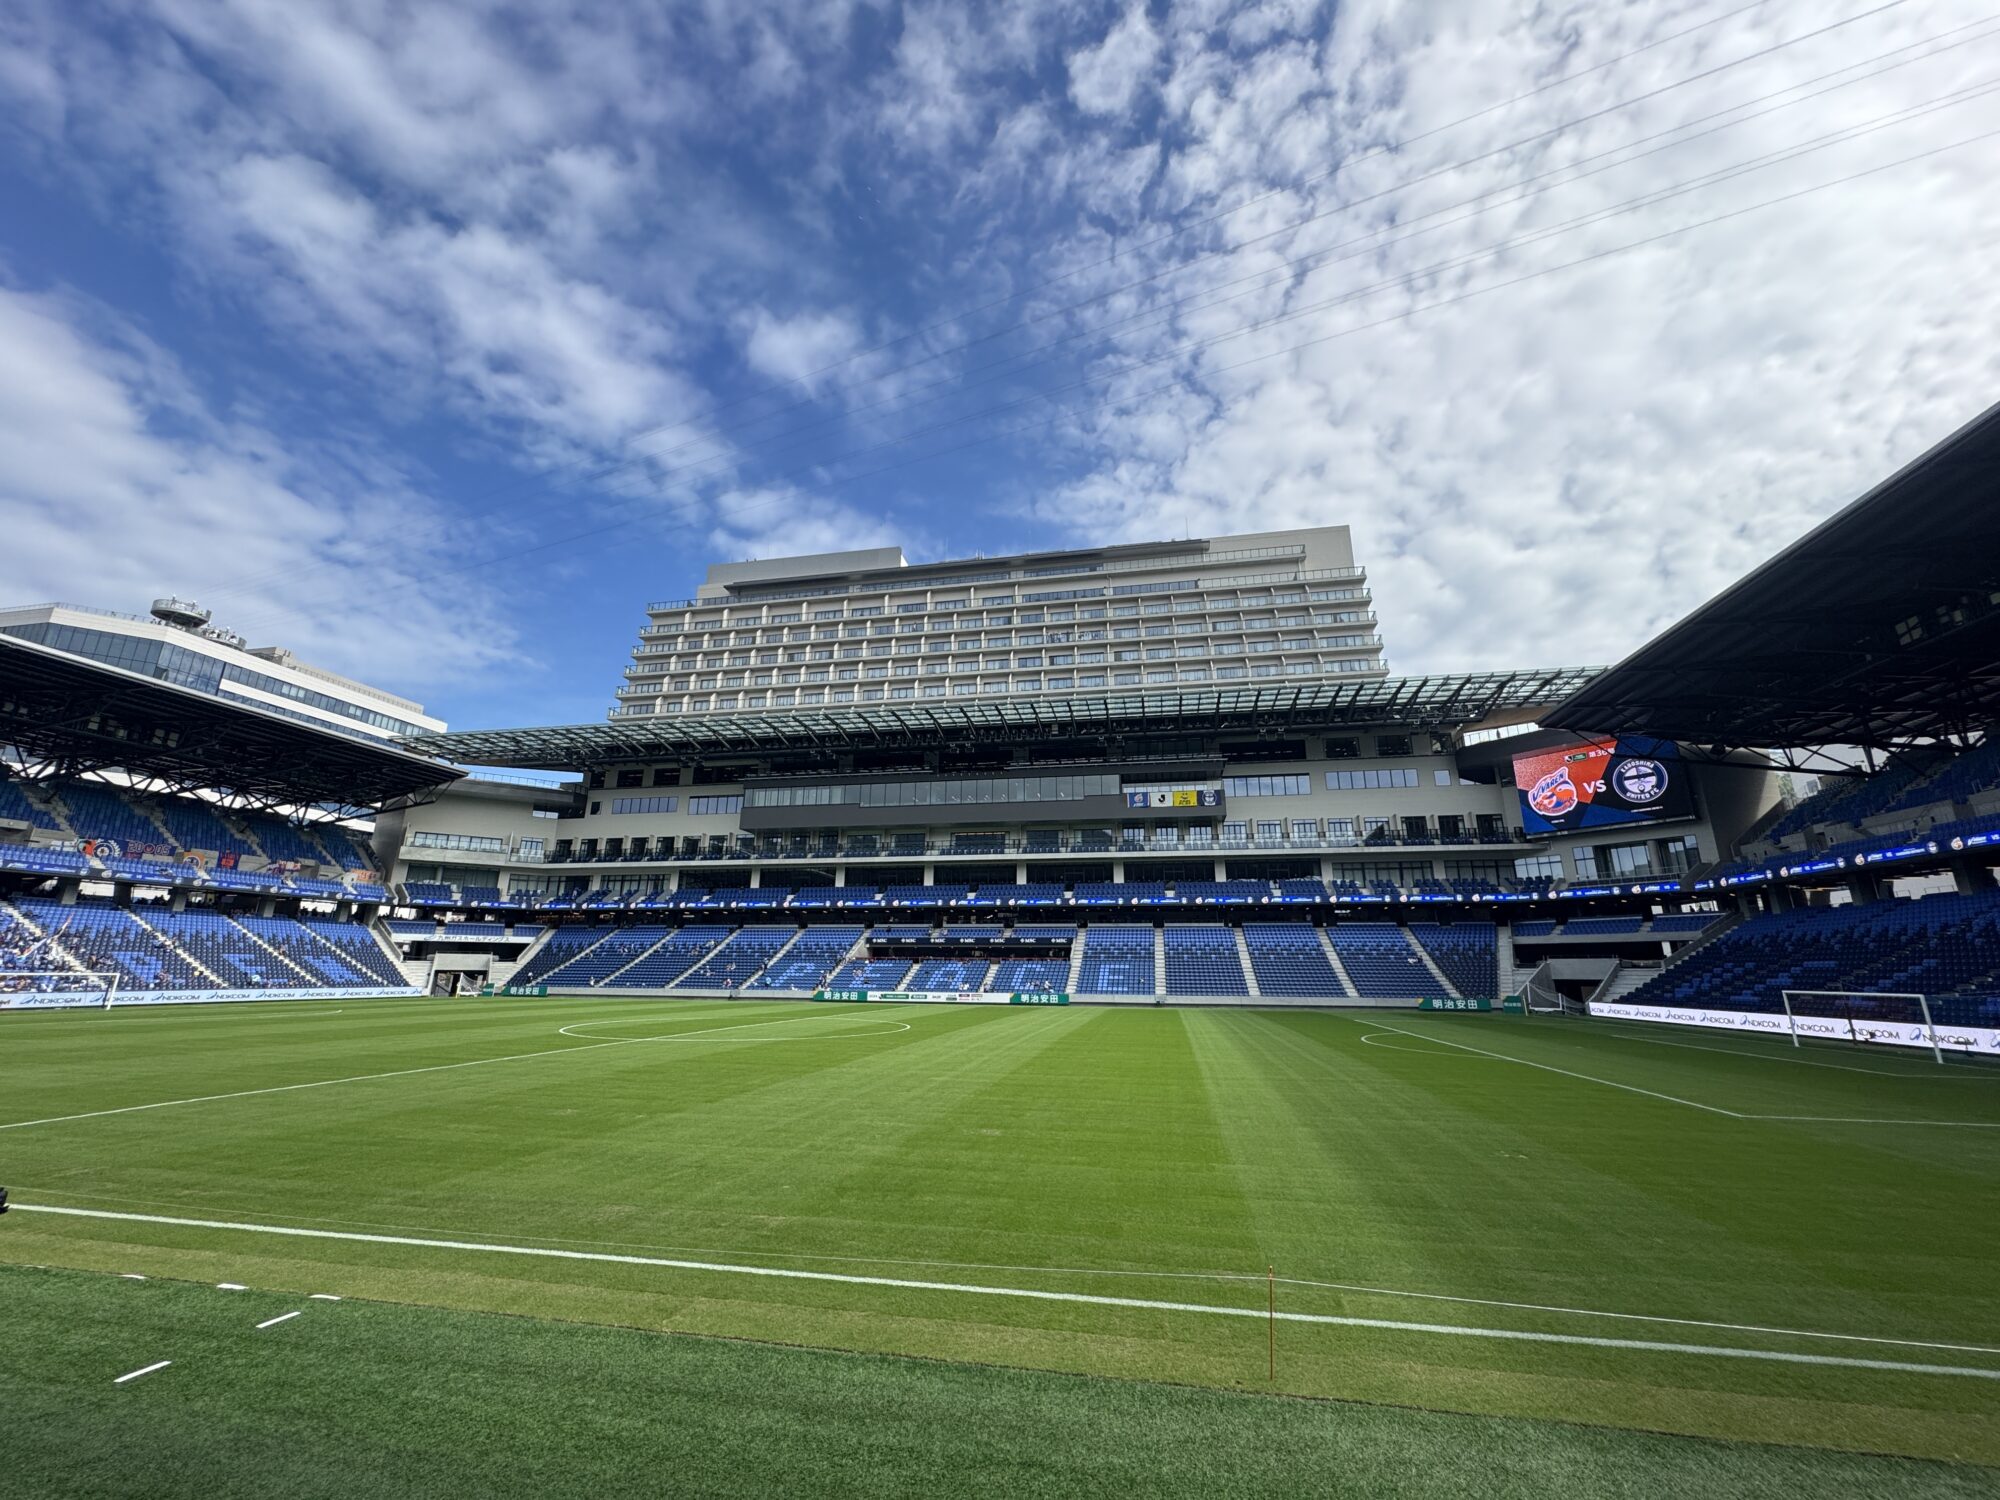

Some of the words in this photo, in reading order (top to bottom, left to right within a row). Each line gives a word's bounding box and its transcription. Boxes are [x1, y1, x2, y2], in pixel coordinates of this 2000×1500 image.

[1583, 780, 1607, 794] VS
[1626, 791, 1651, 800] UNITED
[510, 986, 539, 995] 明治安田
[824, 991, 858, 1000] 明治安田
[1021, 994, 1058, 1003] 明治安田
[1432, 999, 1478, 1009] 明治安田
[1706, 1016, 1735, 1025] NDKCOM
[1748, 1020, 1780, 1028] NDKCOM
[1796, 1024, 1834, 1033] NDKCOM
